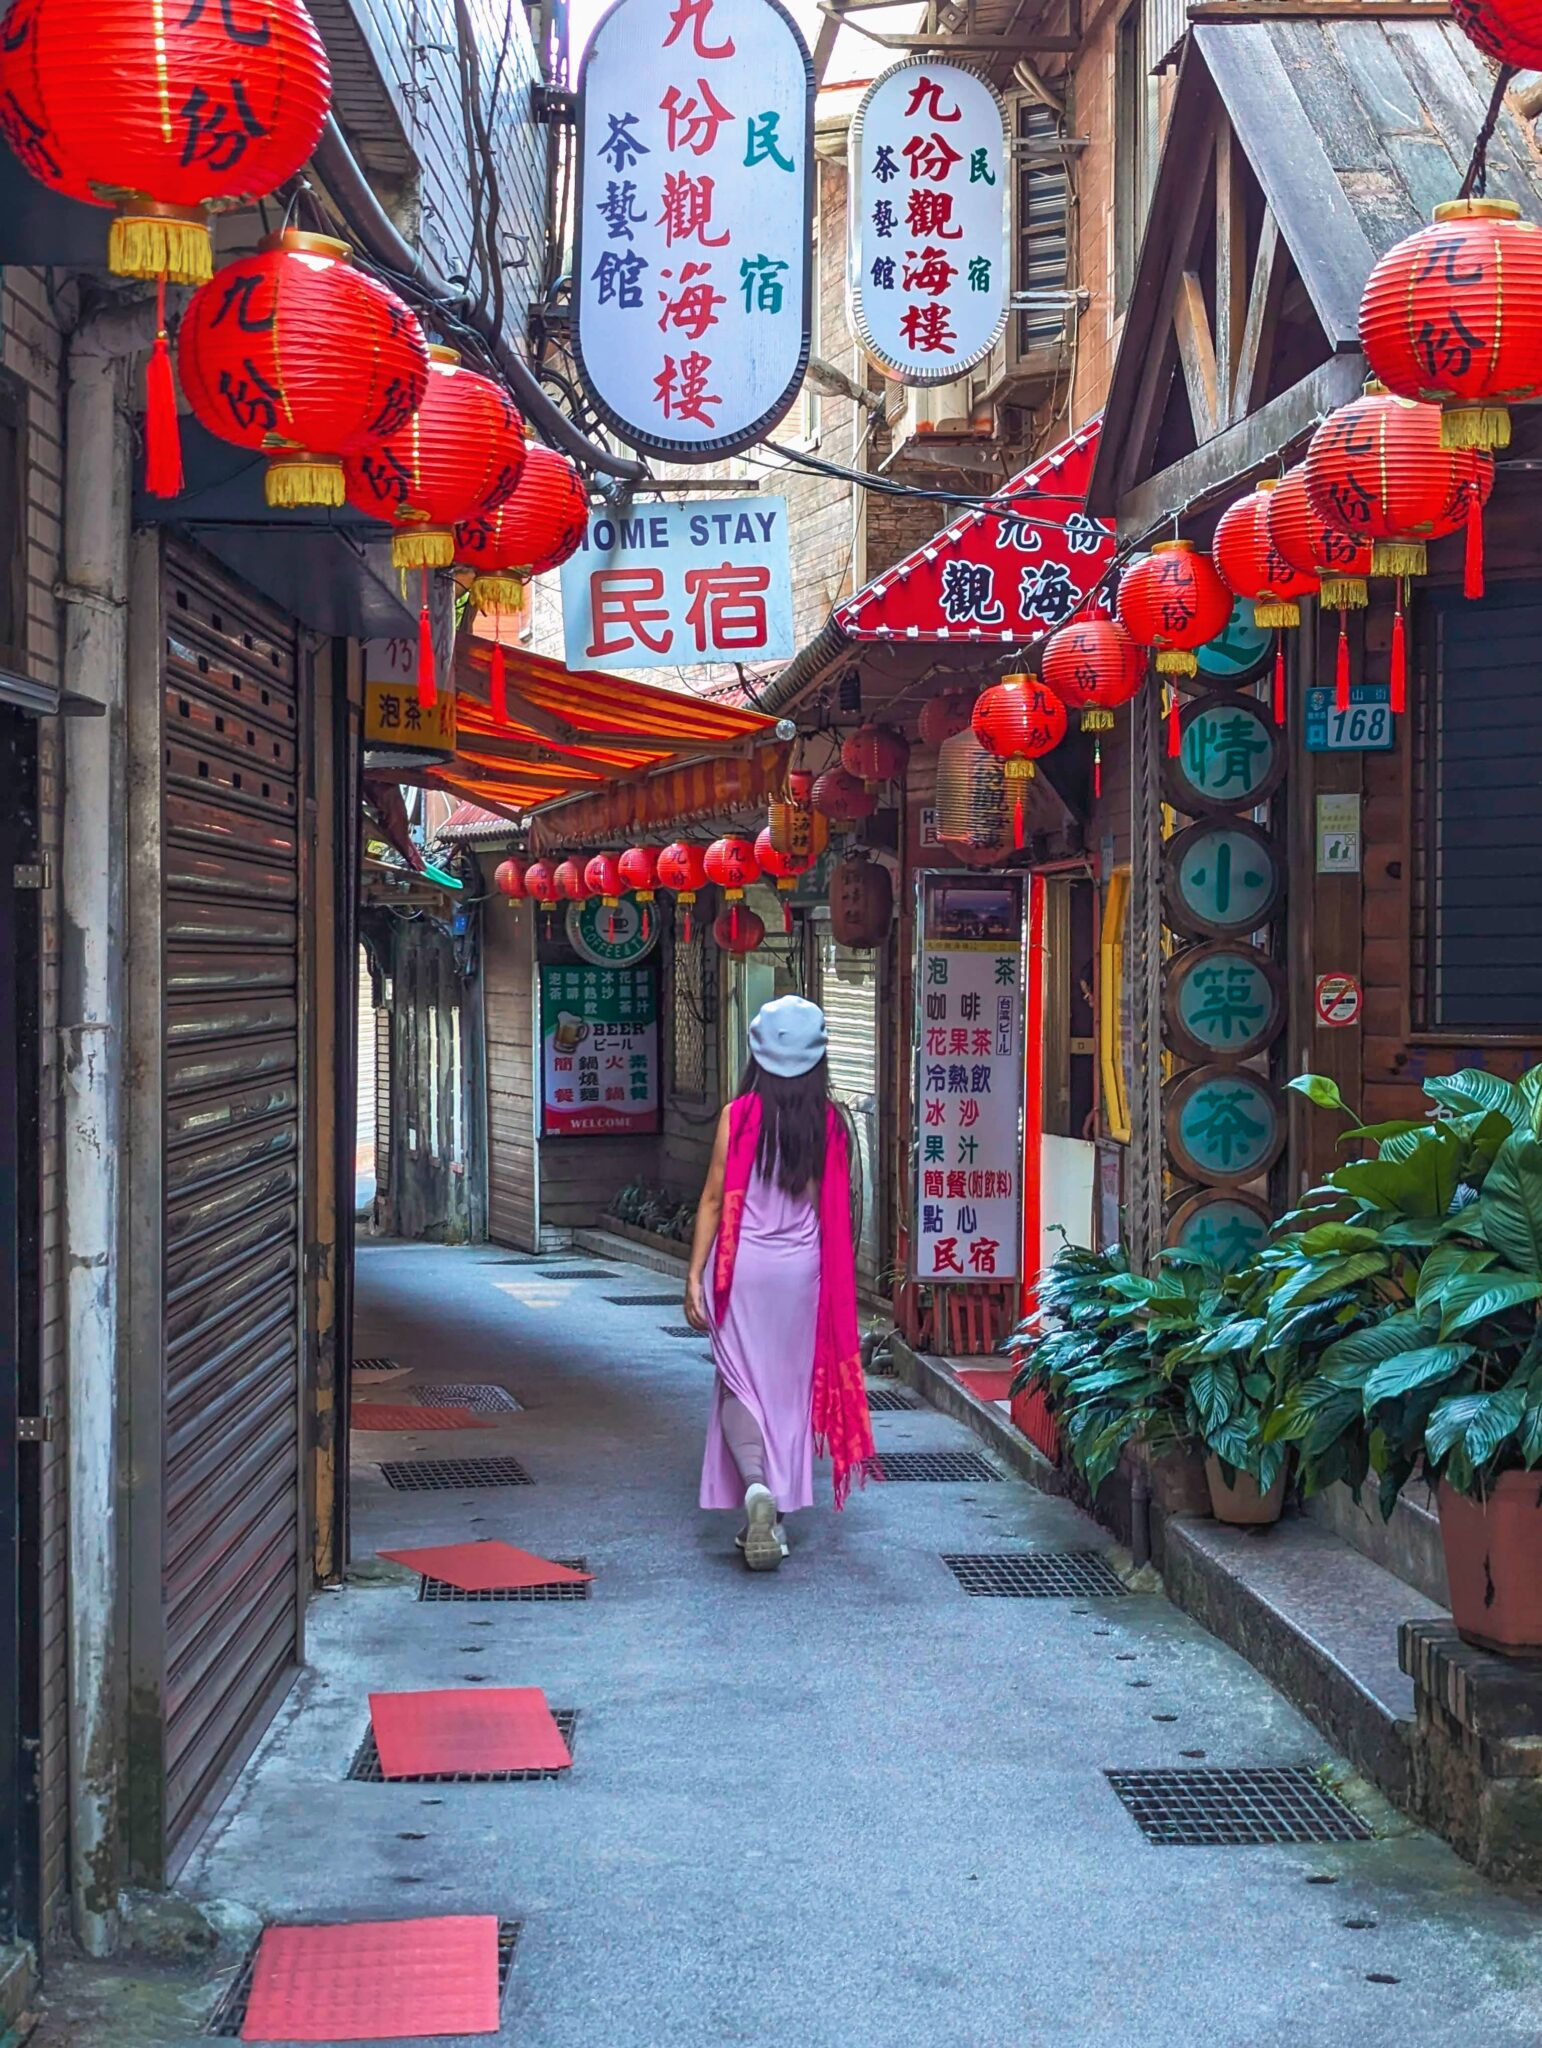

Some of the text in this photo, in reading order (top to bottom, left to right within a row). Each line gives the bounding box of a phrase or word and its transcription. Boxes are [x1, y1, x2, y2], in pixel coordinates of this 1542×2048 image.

[590, 113, 651, 309] 茶藝館
[652, 0, 735, 428] 九份觀海樓
[739, 111, 796, 315] 民宿
[870, 146, 900, 291] 茶藝館
[899, 76, 963, 355] 九份觀海樓
[967, 148, 996, 294] 民宿
[1416, 237, 1487, 378] 九份
[210, 275, 280, 430] 九份
[1327, 411, 1378, 524] 九份
[690, 512, 777, 546] STAY
[996, 510, 1109, 554] 九份
[586, 561, 771, 657] 民宿
[1159, 560, 1195, 632] 九份
[1071, 633, 1098, 691] 九份
[1333, 708, 1386, 742] 168
[927, 956, 1016, 986] 泡茶
[927, 992, 981, 1022] 咖啡
[593, 1022, 646, 1036] BEER
[594, 1037, 634, 1051] ビール
[926, 1027, 992, 1056] 花果茶
[925, 1064, 991, 1093] 冷熱飲
[570, 1117, 632, 1129] WELCOME
[925, 1098, 979, 1127] 冰沙
[924, 1135, 978, 1164] 果汁
[923, 1205, 977, 1234] 點心
[932, 1236, 1000, 1274] 民宿
